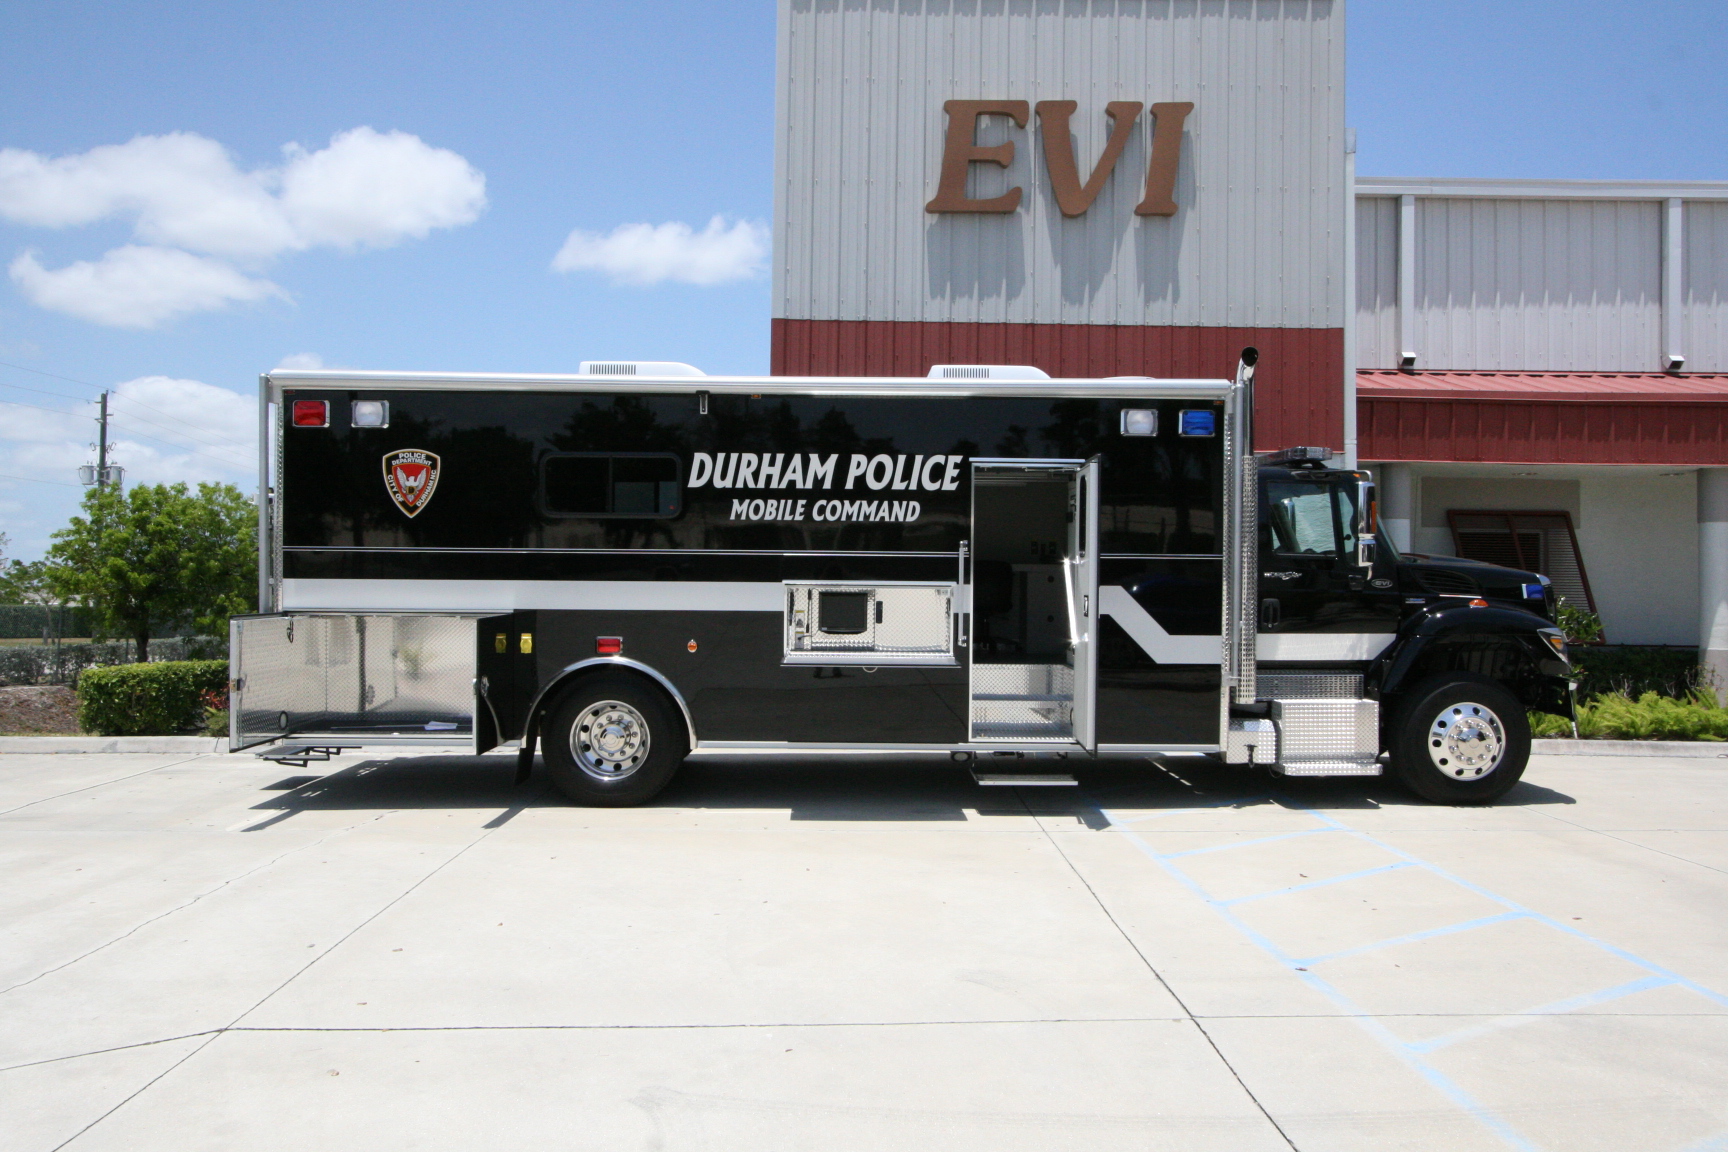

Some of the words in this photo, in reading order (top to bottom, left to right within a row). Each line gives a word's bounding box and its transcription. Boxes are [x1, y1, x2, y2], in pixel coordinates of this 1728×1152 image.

[925, 100, 1194, 217] EVI
[391, 458, 432, 466] DEPARTMENT
[398, 452, 426, 460] POLICE
[387, 474, 398, 493] CITY
[687, 452, 839, 489] DURHAM
[844, 454, 964, 491] POLICE
[416, 480, 434, 507] DURHAM
[729, 498, 807, 521] MOBILE
[812, 500, 921, 522] COMMAND
